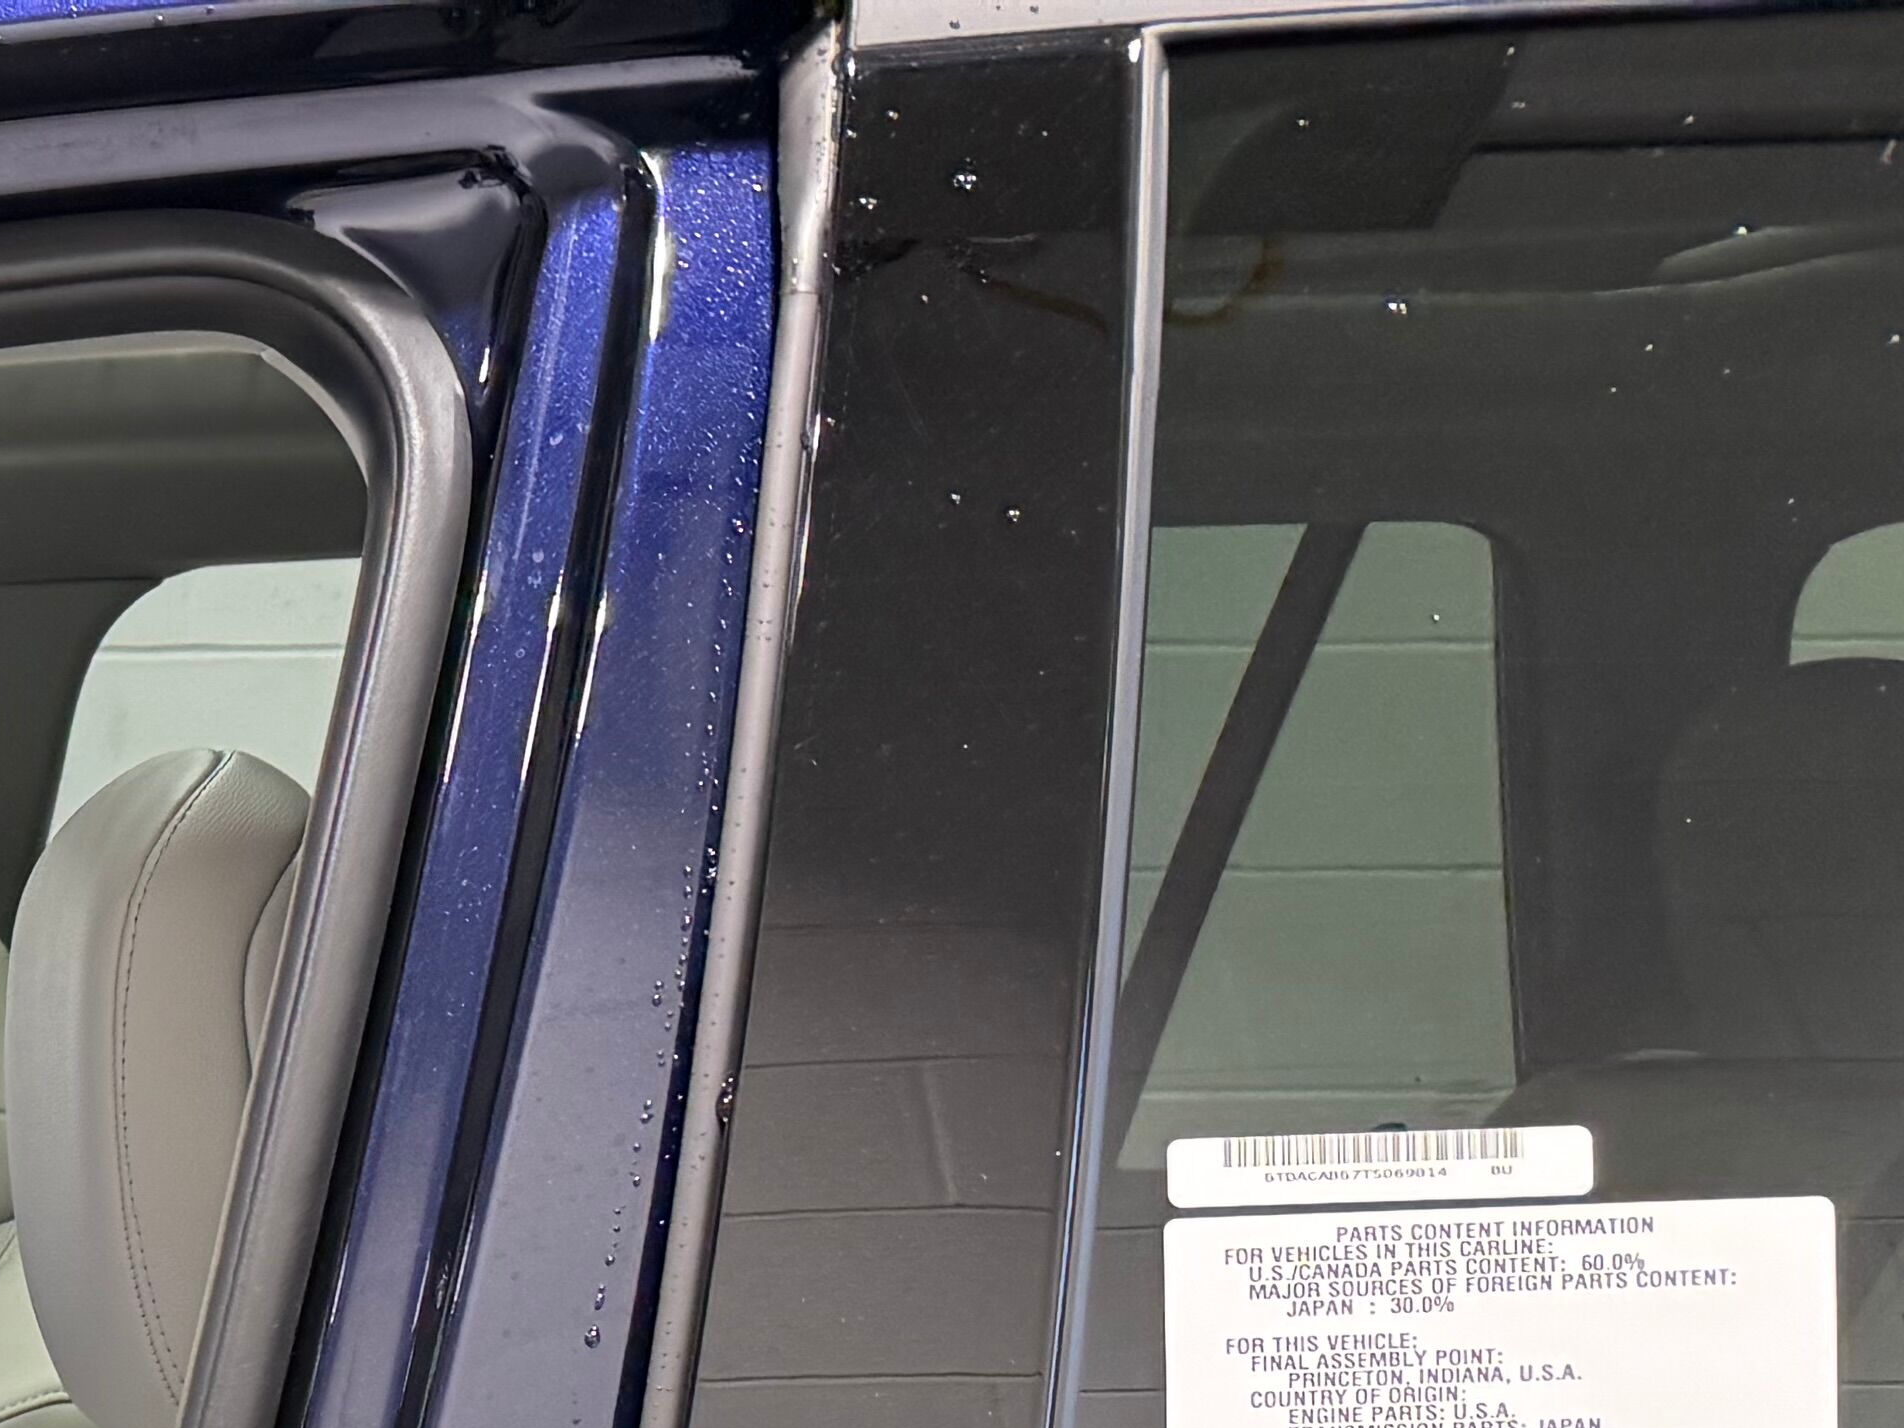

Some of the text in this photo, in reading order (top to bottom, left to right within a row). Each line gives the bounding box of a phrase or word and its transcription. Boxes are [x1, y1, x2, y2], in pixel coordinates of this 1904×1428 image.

[1336, 1217, 1654, 1243] PARTS CONTENT INFORMATION
[1224, 1238, 1553, 1265] FOR VEHICLES IN THIS CARLINE:
[1249, 1253, 1645, 1282] U.S./CANADA PARTS CONTENT: 60.0%
[1248, 1268, 1737, 1300] MAJOR SOURCES OF FOREIGN PARTS CONTENT:
[1287, 1299, 1354, 1317] JAPAN
[1390, 1295, 1454, 1314] 30.0%
[1226, 1333, 1418, 1354] FOR THIS VEHICLE:
[1251, 1348, 1504, 1371] FINAL ASSEMBLY POINT:
[1288, 1364, 1583, 1389] PRINCETON, INDIANA, U.S.A.
[1250, 1386, 1467, 1408] COUNTRY OF ORIGIN:
[1289, 1402, 1516, 1424] ENGINE PARTS: U.S.A.
